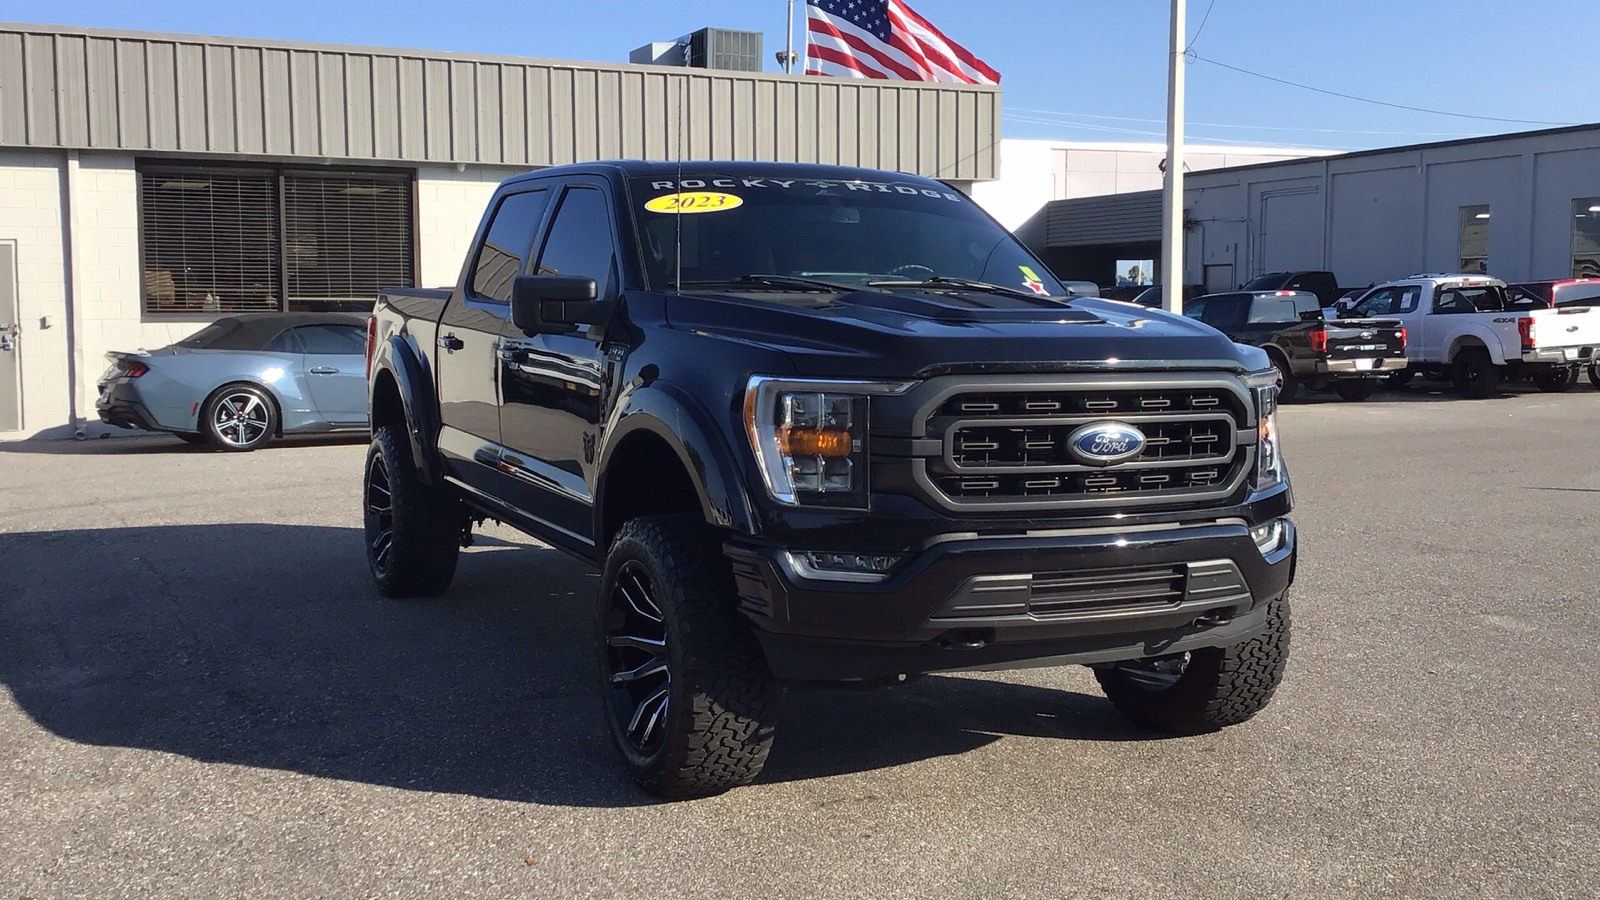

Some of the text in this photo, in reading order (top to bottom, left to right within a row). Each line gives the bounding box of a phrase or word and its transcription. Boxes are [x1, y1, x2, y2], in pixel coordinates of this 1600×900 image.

[650, 178, 961, 202] ROCKY RIDGE
[664, 195, 727, 210] 2023
[1091, 432, 1130, 453] Ford
